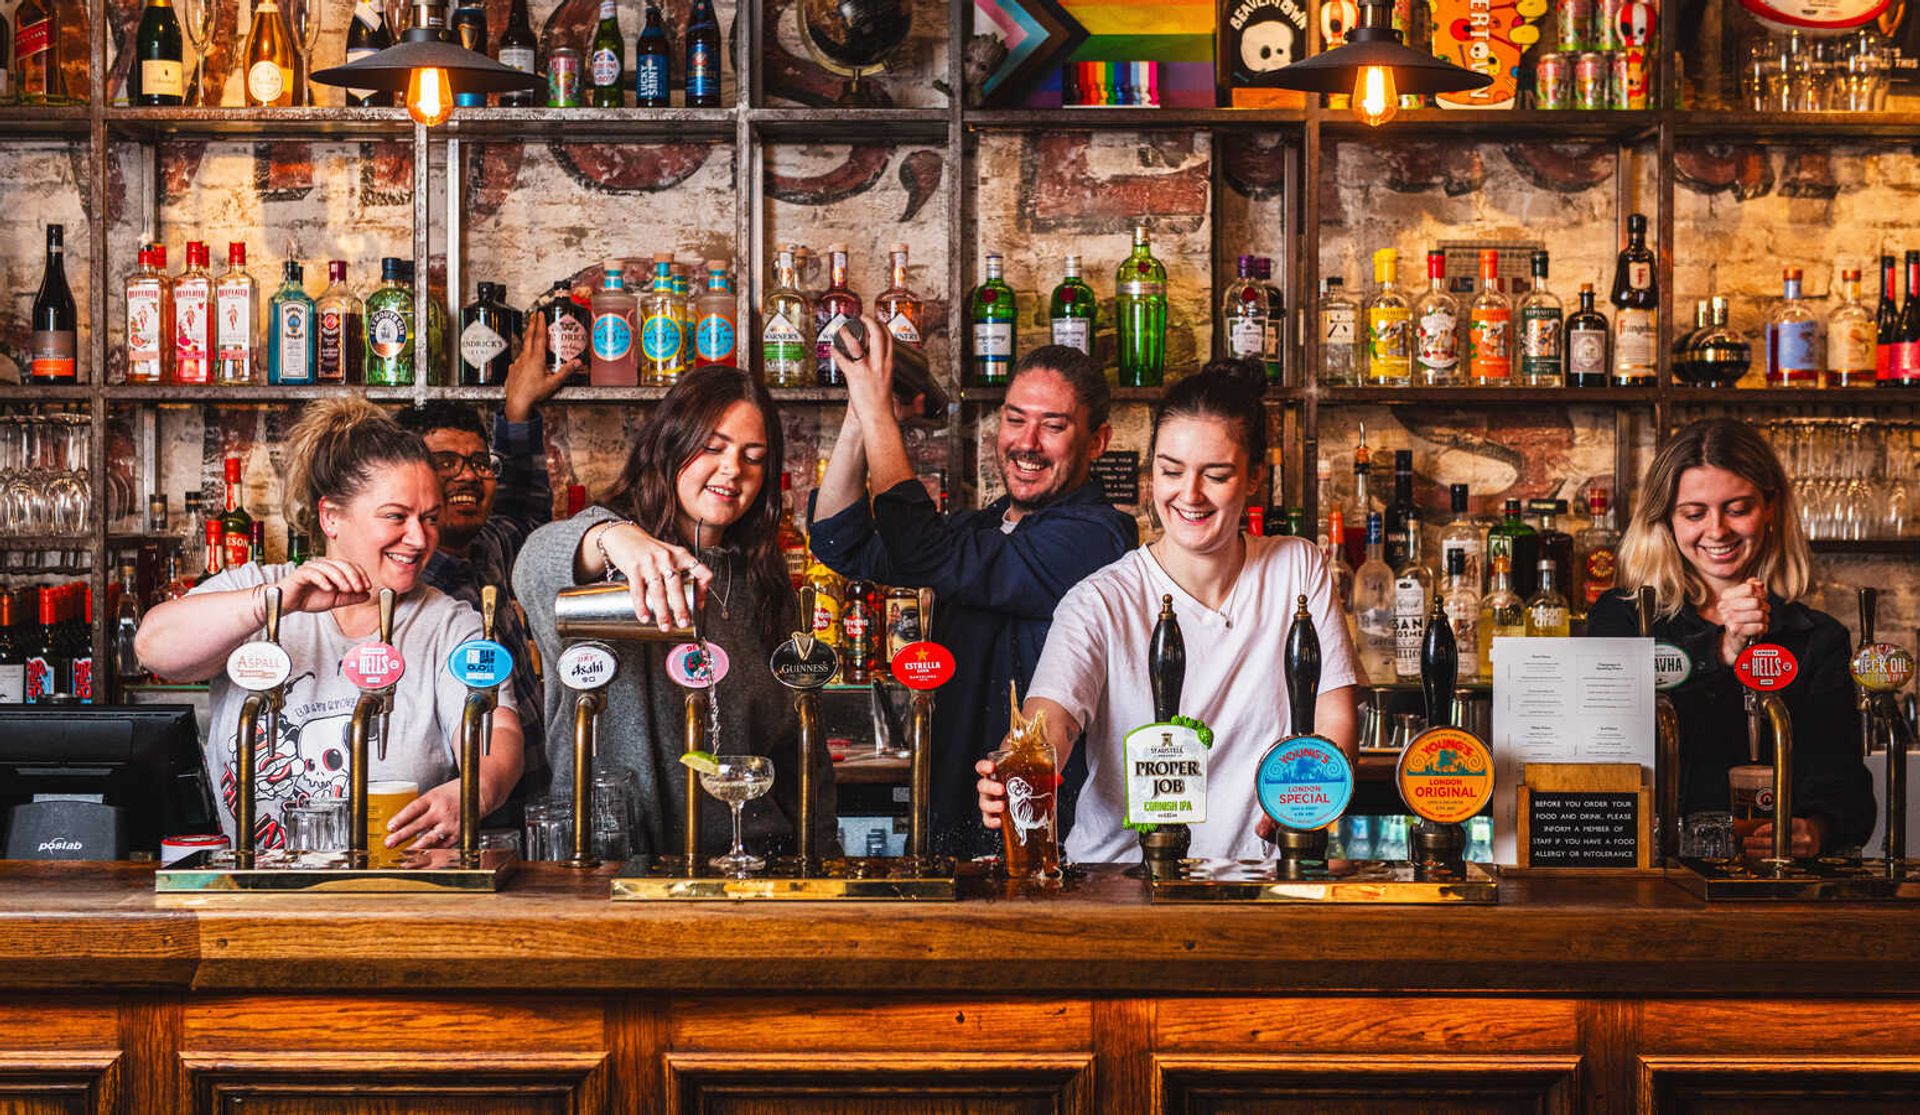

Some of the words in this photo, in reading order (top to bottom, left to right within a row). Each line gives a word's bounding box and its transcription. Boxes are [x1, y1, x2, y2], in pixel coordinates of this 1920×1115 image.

[648, 65, 658, 97] SAINT
[237, 655, 281, 668] ASPALL
[358, 655, 389, 675] HELLS
[571, 660, 604, 676] Asahi
[781, 663, 829, 674] GUINNESS
[904, 661, 941, 670] ESTRELLA
[1752, 657, 1782, 676] HELLS
[1890, 657, 1909, 673] OIL
[1421, 738, 1474, 757] YOUNG'S
[1279, 747, 1332, 765] YOUNG'S
[1134, 760, 1202, 777] PROPER
[1150, 779, 1186, 800] JOB
[1288, 785, 1322, 793] LONDON
[1414, 786, 1478, 798] ORIGINAL
[1143, 800, 1178, 812] CORNISH
[1179, 800, 1193, 812] IPA
[1279, 793, 1331, 805] SPECIAL
[1535, 800, 1561, 808] BEFORE
[1564, 800, 1581, 808] YOU
[1583, 800, 1608, 808] ORDER
[1612, 800, 1632, 808] YOUR
[1535, 850, 1566, 858] ALLERGY
